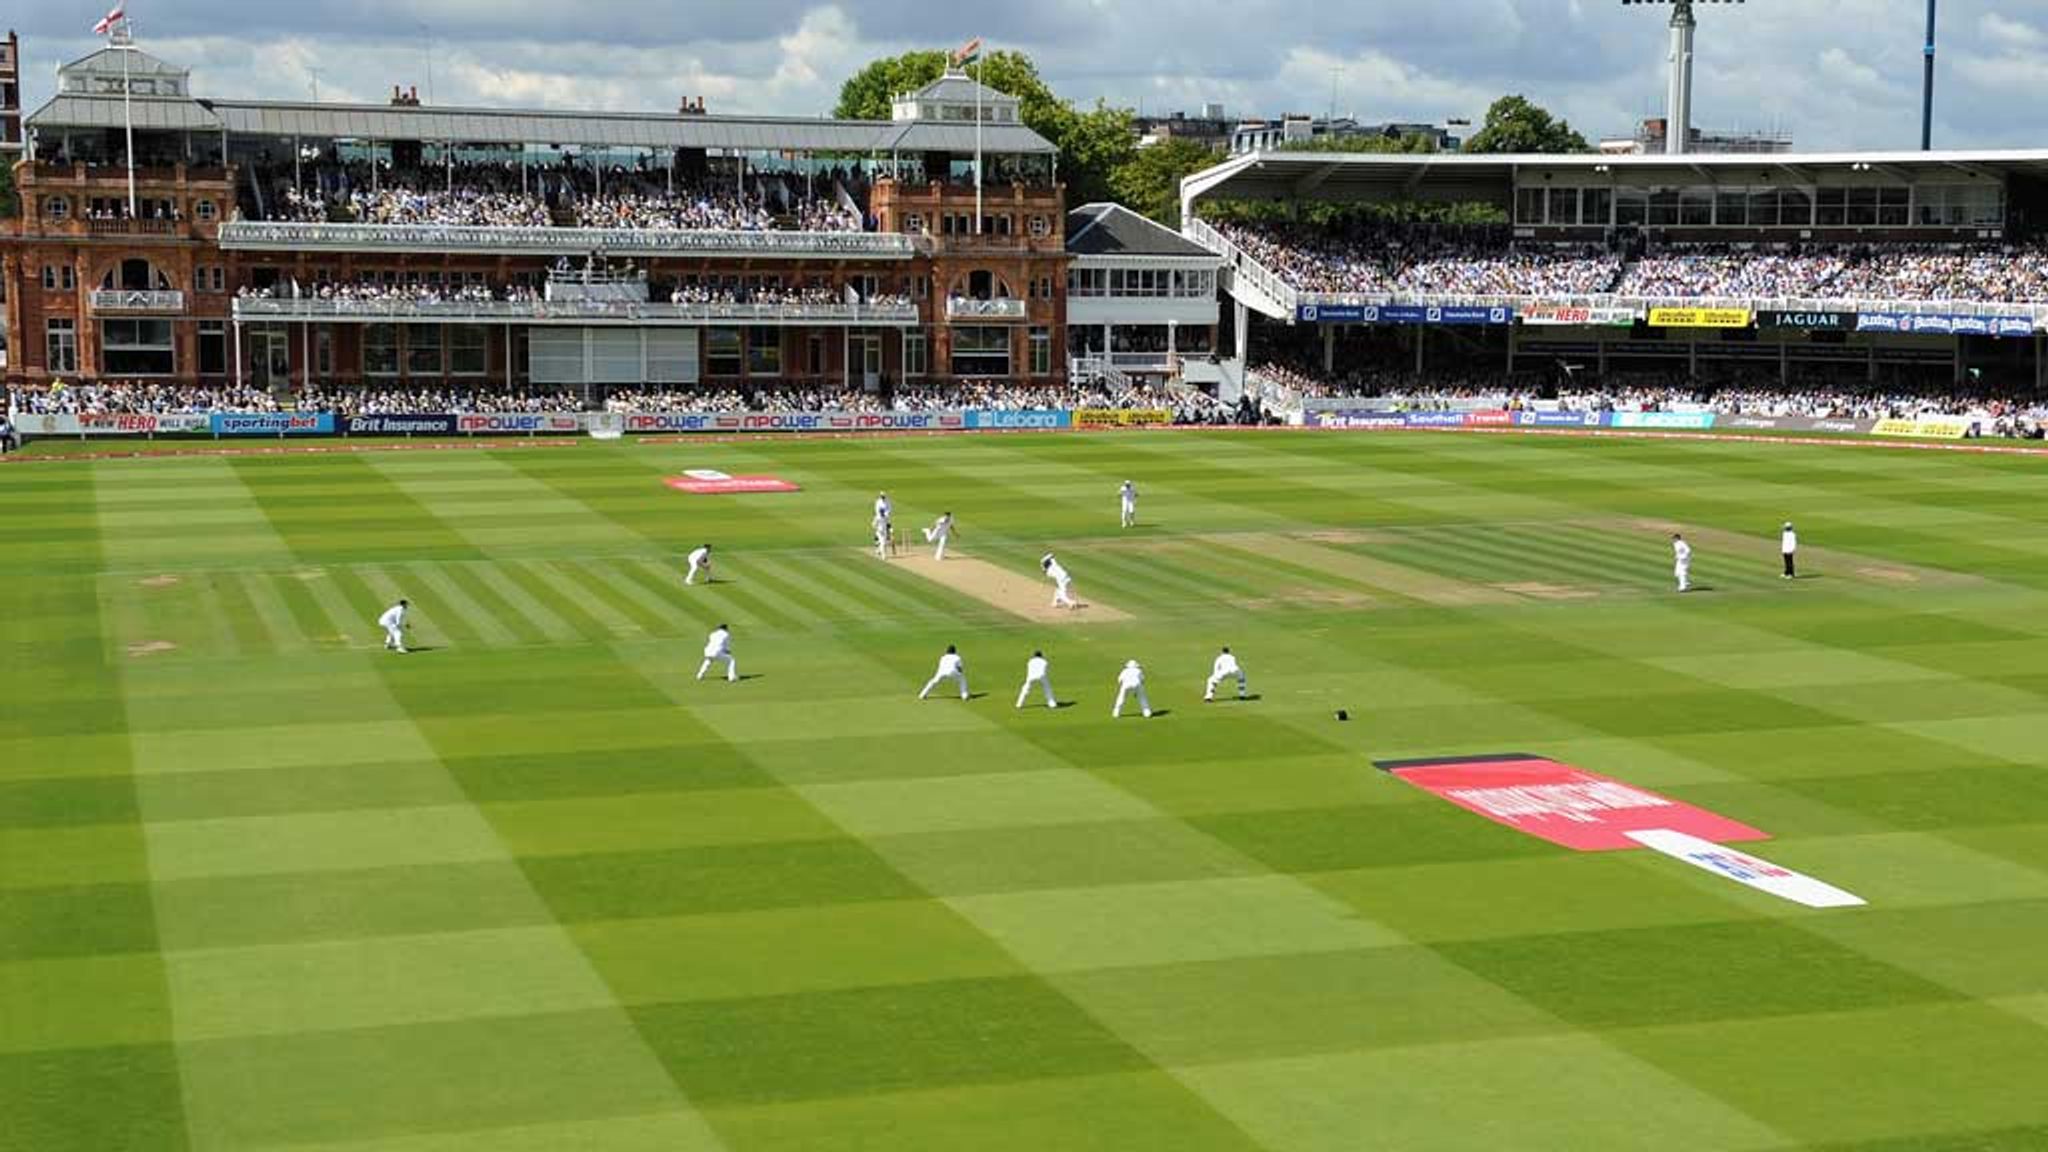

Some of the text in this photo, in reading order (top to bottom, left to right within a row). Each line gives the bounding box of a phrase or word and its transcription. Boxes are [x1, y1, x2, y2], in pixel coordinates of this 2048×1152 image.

[1556, 309, 1589, 321] HERO
[1776, 313, 1838, 326] JAGUAR
[117, 414, 158, 431] HERO
[223, 416, 317, 430] sportingbet
[350, 418, 448, 432] Brit Insurance
[460, 415, 545, 430] npower
[628, 414, 709, 429] npower
[744, 414, 823, 429] npower
[856, 414, 933, 428] npower
[994, 410, 1057, 427] Lebara
